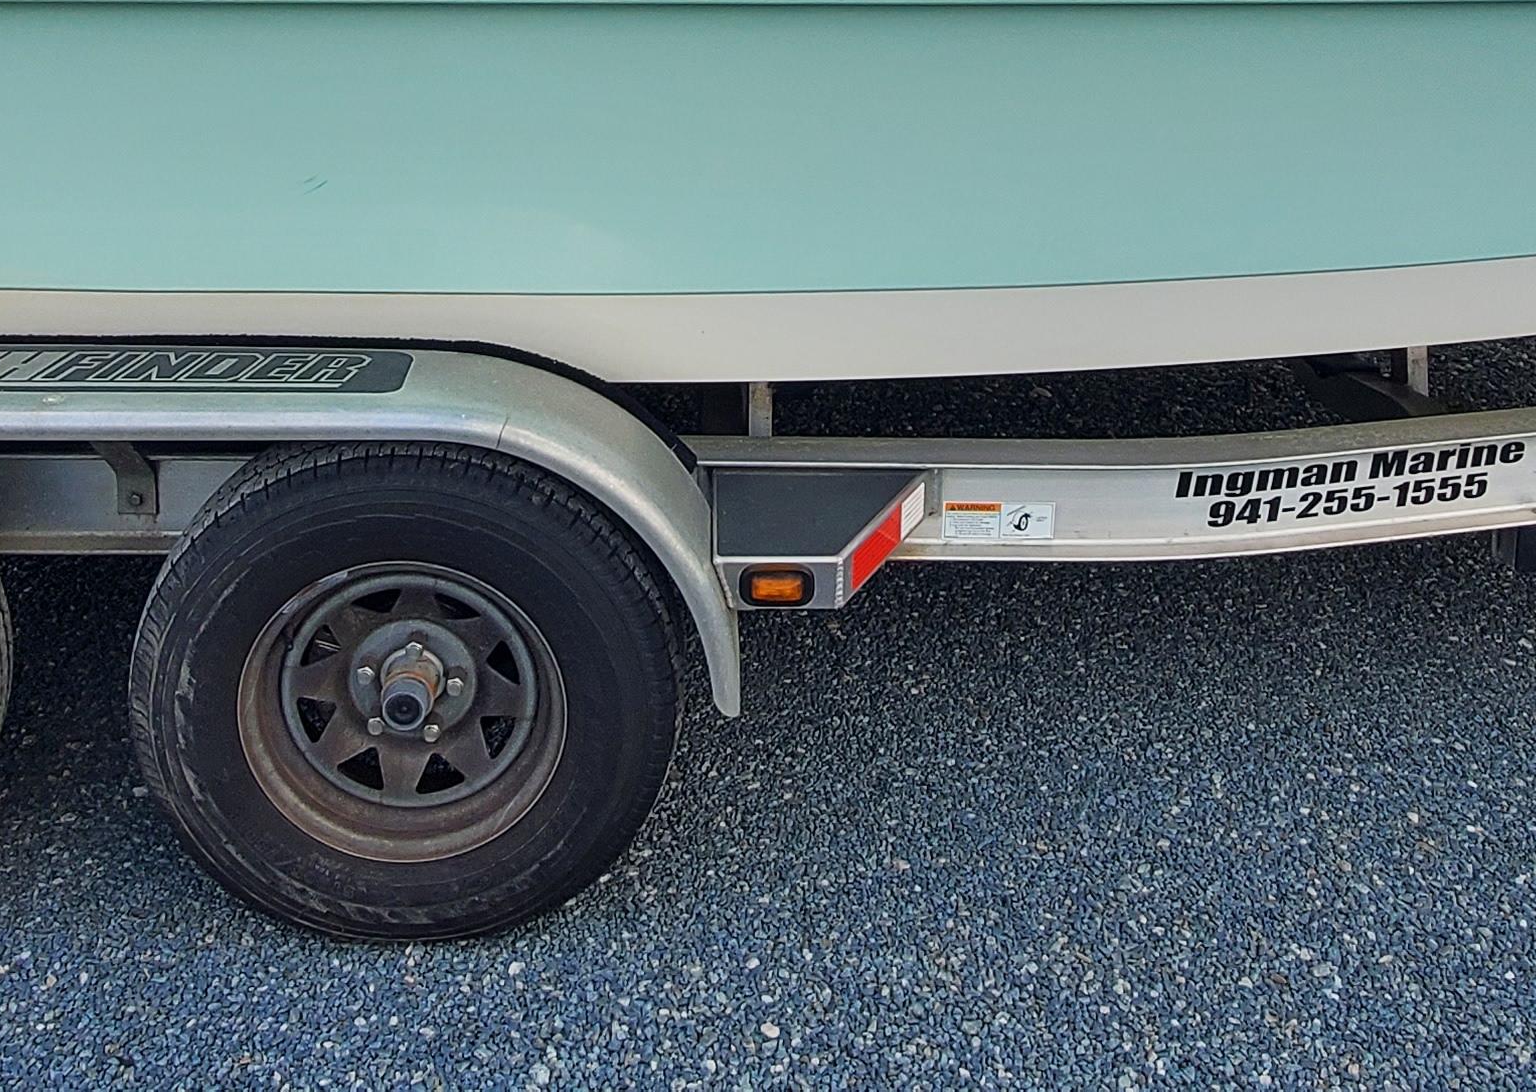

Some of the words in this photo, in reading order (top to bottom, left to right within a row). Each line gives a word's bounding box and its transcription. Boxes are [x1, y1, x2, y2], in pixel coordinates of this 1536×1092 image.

[1175, 459, 1359, 499] Ingman
[1368, 441, 1526, 479] Marine
[1207, 473, 1489, 528] 941-255-1555
